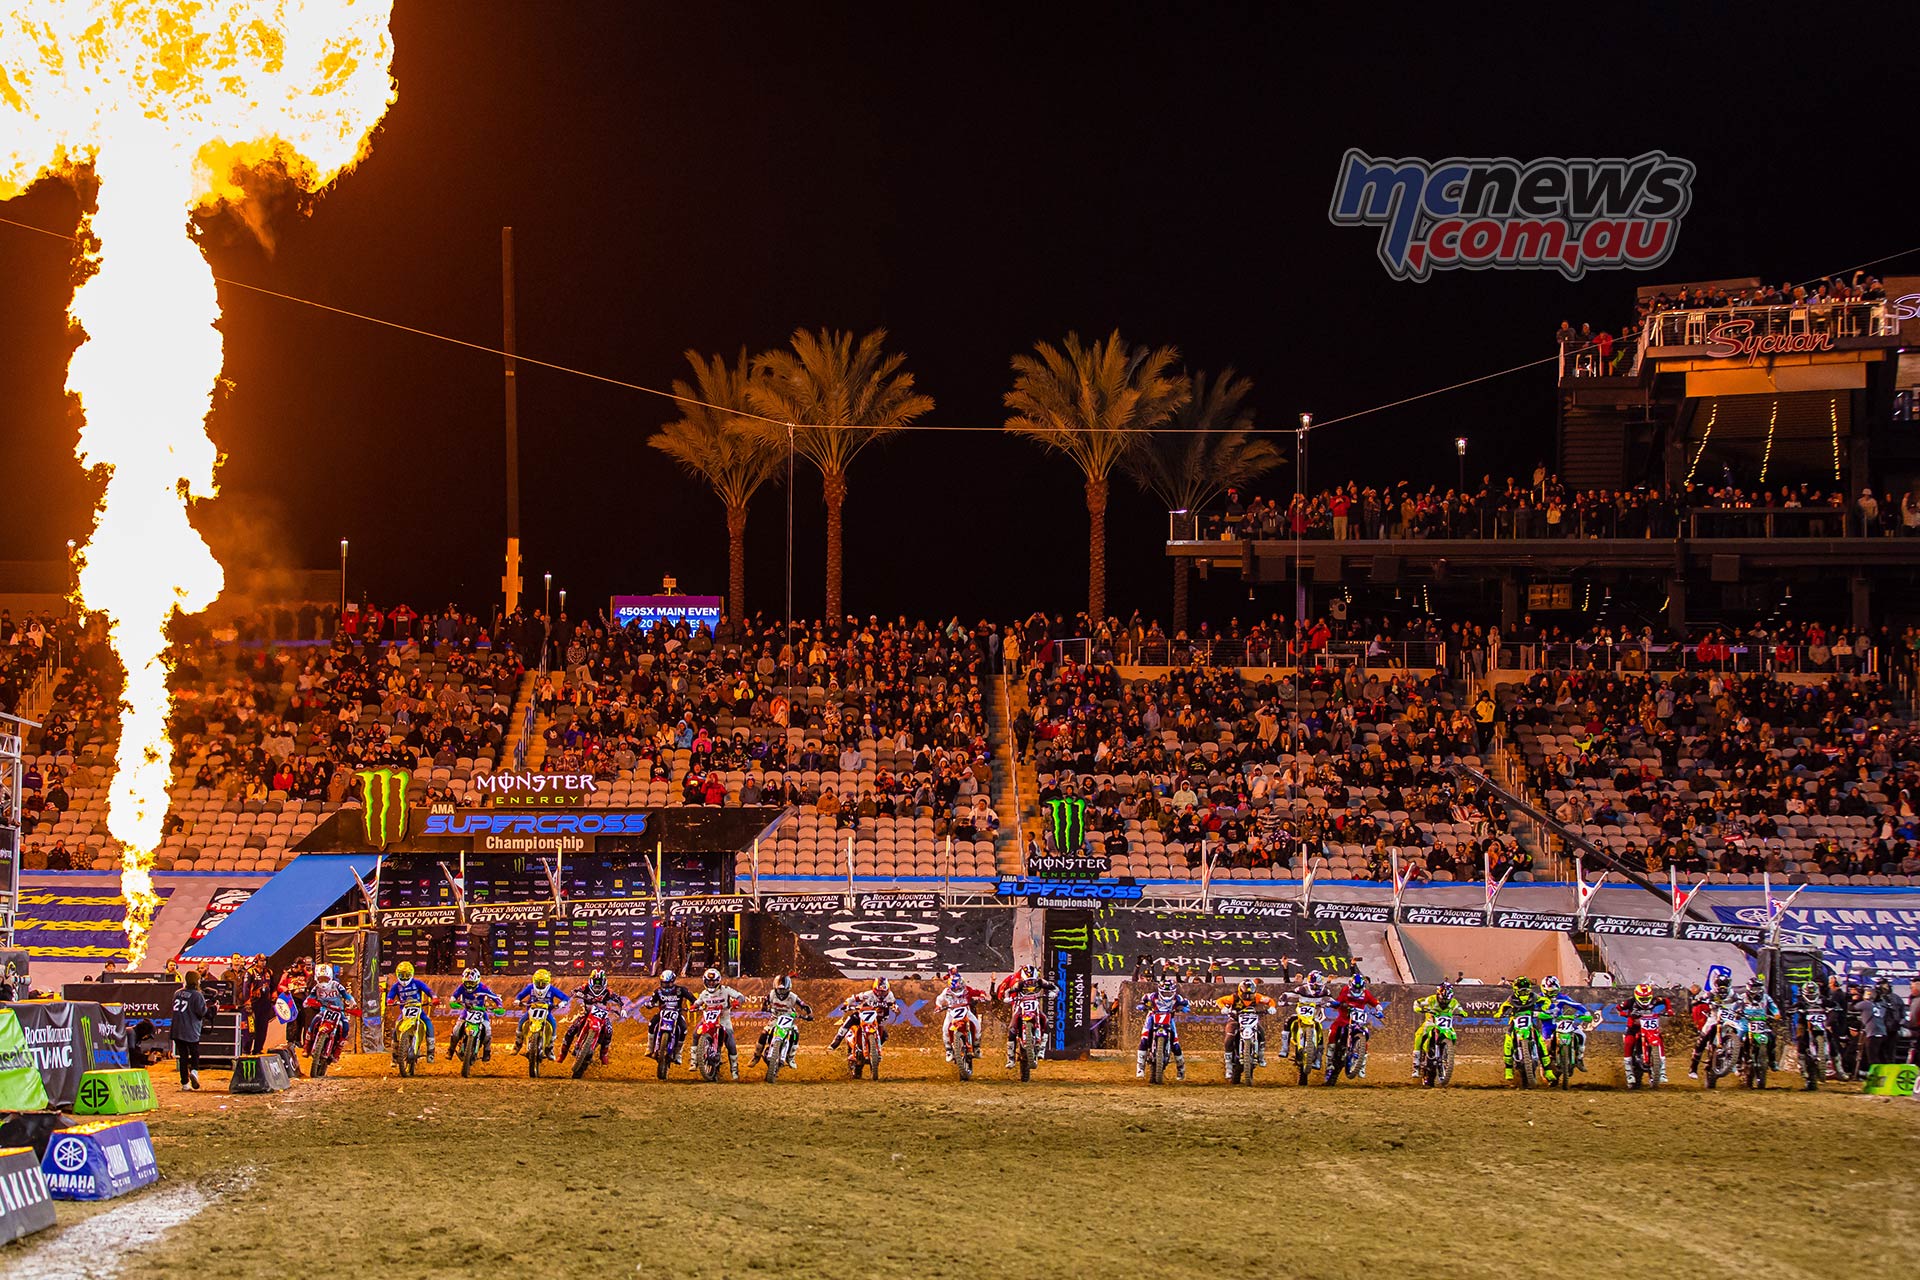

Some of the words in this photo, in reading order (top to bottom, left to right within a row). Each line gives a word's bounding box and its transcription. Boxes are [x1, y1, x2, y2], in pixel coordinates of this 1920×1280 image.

[1706, 320, 1834, 365] Sycuan
[619, 607, 654, 616] 450SX
[657, 607, 685, 616] MAIN
[640, 619, 653, 628] 20
[477, 772, 597, 793] MONSTER
[496, 796, 579, 804] ENERGY
[431, 804, 455, 814] AMA
[423, 814, 648, 833] SUPERCROSS
[486, 835, 584, 851] Championship
[1029, 857, 1108, 870] MONSTER
[997, 882, 1143, 899] SUPERCROSS
[1037, 897, 1102, 908] Championship
[1229, 898, 1252, 906] ROCKY
[1253, 900, 1293, 909] MOUNTAIN
[1350, 905, 1389, 914] MOUNTAIN
[1443, 909, 1482, 918] MOUNTAIN
[1511, 912, 1534, 920] ROCKY
[1535, 914, 1573, 923] MOUNTAIN
[1784, 909, 1920, 924] YAMAH
[1605, 918, 1629, 926] ROCKY
[1630, 919, 1668, 928] MOUNTAIN
[1136, 929, 1296, 940] MONSTER
[1698, 924, 1721, 932] ROCKY
[1722, 926, 1760, 936] MOUNTAIN
[799, 934, 966, 943] OAKLEY
[829, 962, 963, 970] AKLEY
[173, 999, 188, 1012] 27
[1056, 951, 1067, 1051] SUPERCROSS
[1074, 973, 1084, 1028] MONSTER
[1466, 1001, 1501, 1010] MONST
[123, 1002, 160, 1012] ONSTER
[404, 1007, 418, 1016] 12
[1023, 1002, 1036, 1011] 51
[1299, 1007, 1313, 1015] 94
[324, 1010, 339, 1020] 60
[467, 1011, 483, 1021] 73
[532, 1009, 545, 1019] 11
[705, 1010, 719, 1020] 15
[862, 1011, 875, 1021] 7
[953, 1008, 965, 1019] 2
[1158, 1014, 1166, 1023] 1
[1352, 1012, 1366, 1020] 14
[777, 1016, 793, 1025] 17
[1437, 1017, 1451, 1028] 21
[1517, 1016, 1529, 1028] 9
[1558, 1020, 1573, 1031] 47
[1643, 1019, 1658, 1029] 45
[43, 1173, 96, 1190] YAMAHA
